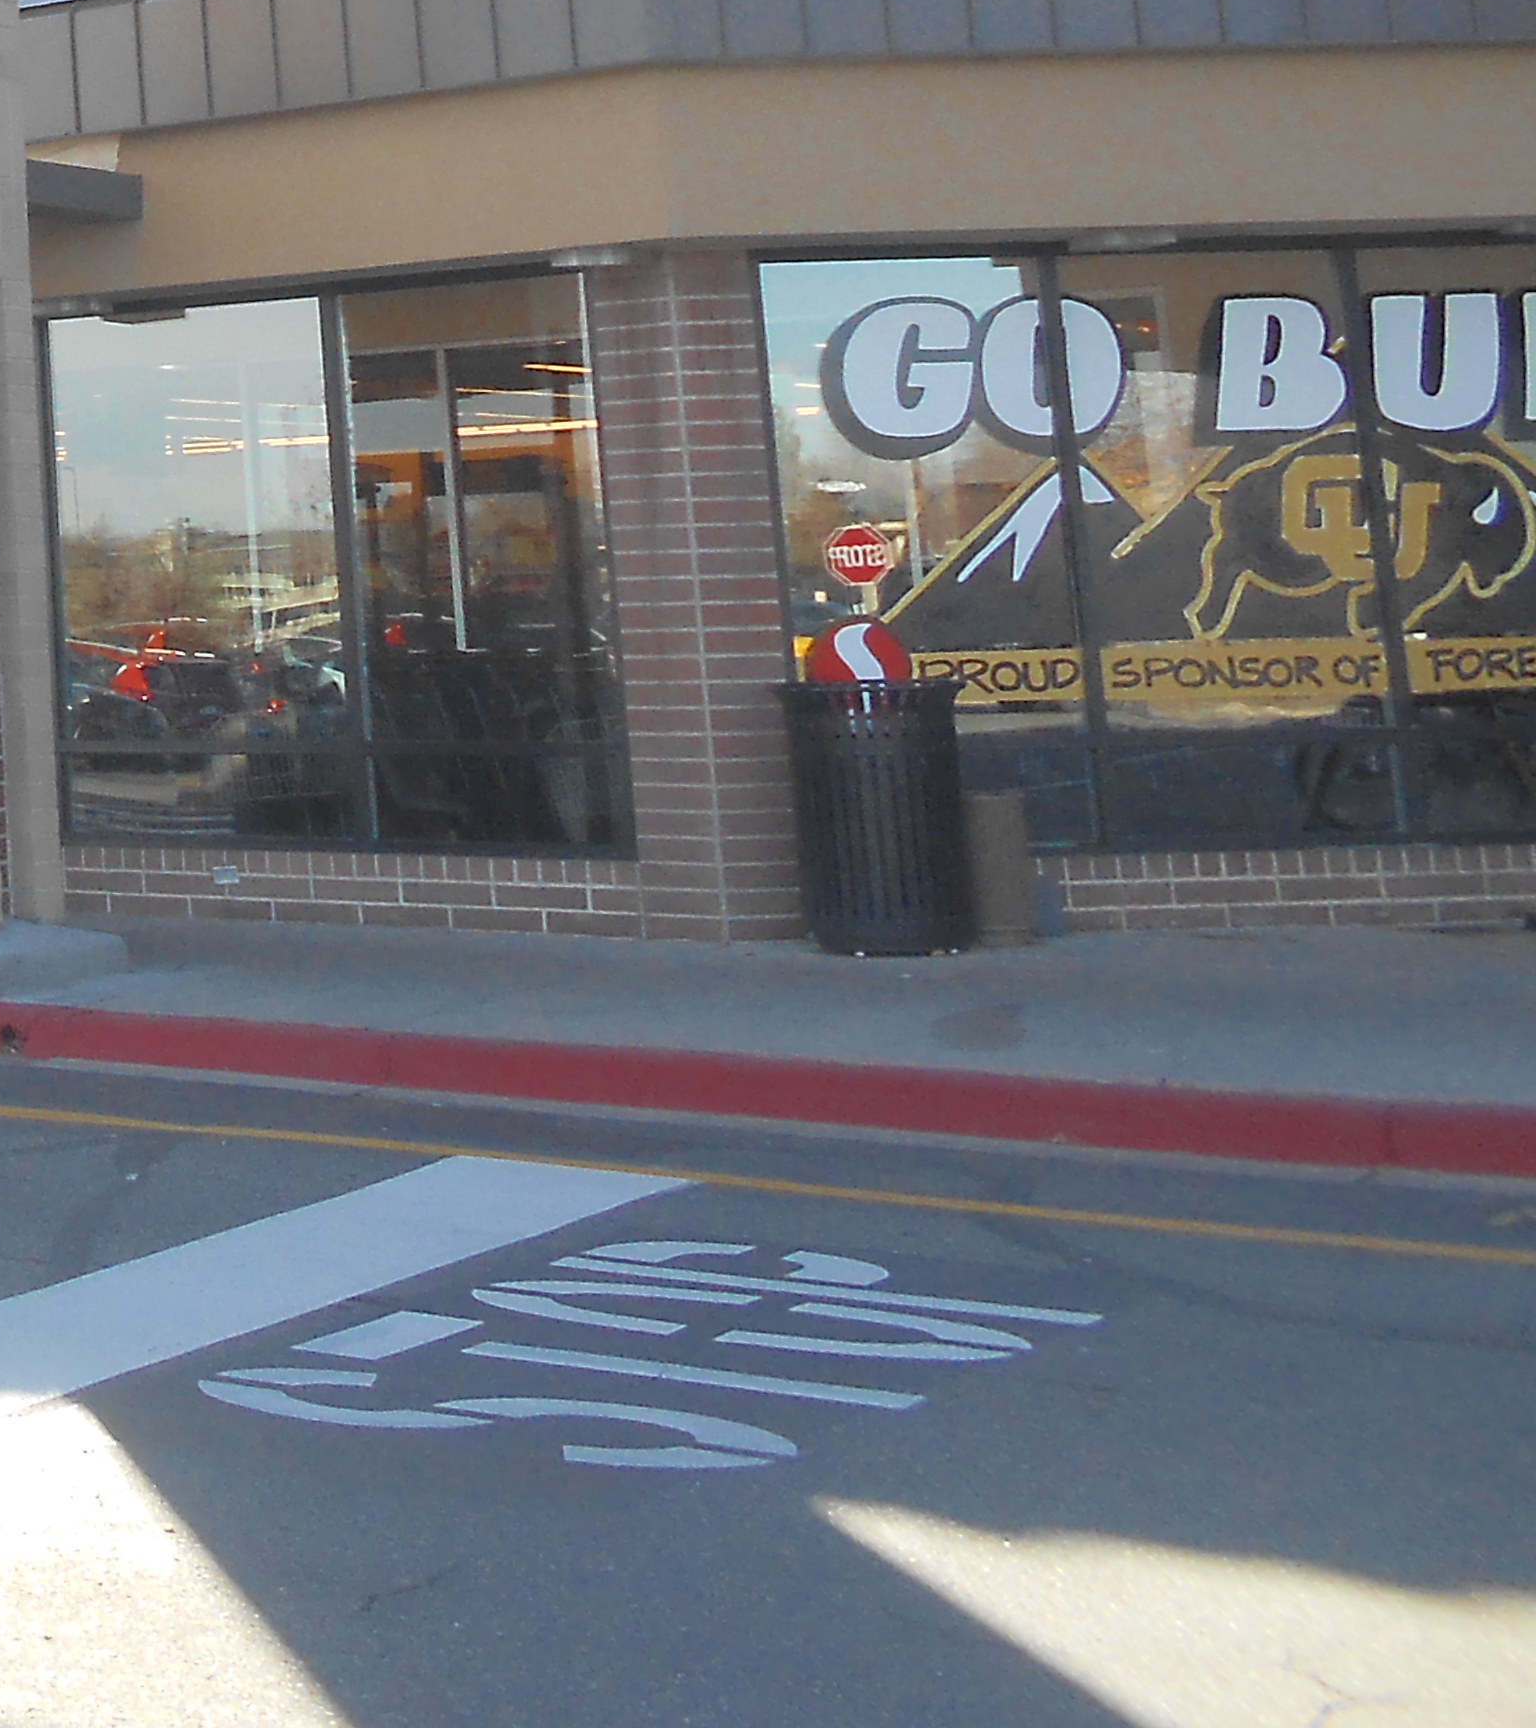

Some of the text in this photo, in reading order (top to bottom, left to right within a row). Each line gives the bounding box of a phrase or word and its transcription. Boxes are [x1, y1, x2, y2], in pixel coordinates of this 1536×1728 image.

[834, 291, 1536, 444] GO BU
[917, 657, 1080, 694] PROUD
[1111, 653, 1324, 688] SPONSOR
[1333, 653, 1381, 688] OF
